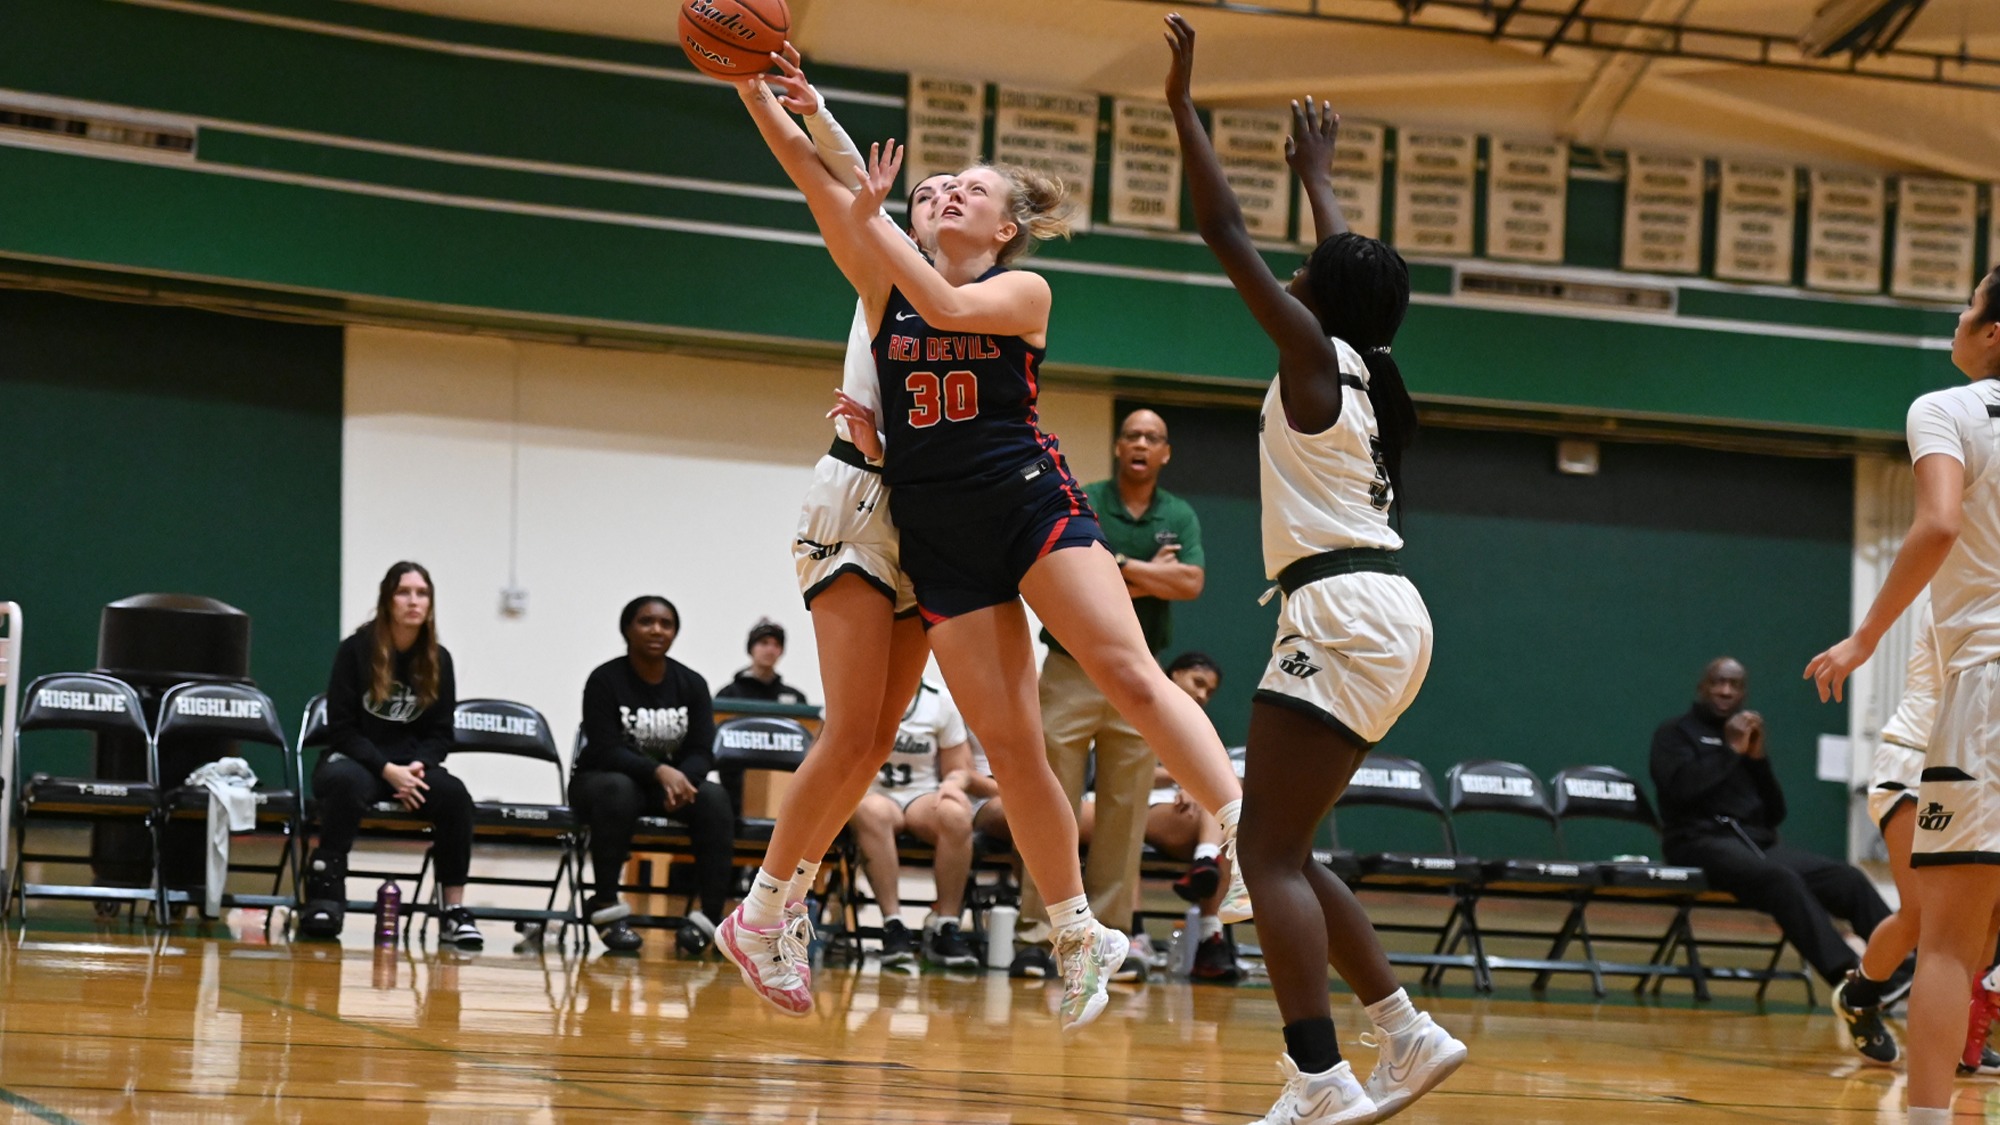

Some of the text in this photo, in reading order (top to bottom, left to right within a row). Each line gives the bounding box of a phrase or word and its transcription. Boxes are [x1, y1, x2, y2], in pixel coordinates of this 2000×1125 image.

[690, 0, 756, 40] Baden
[686, 36, 736, 68] RIVAL
[926, 335, 1001, 361] DEVILS
[905, 370, 979, 429] 30
[38, 689, 127, 713] HIGHLINE
[175, 696, 263, 718] HIGHLINE
[453, 711, 537, 736] HIGHLINE
[720, 729, 804, 752] HIGHLINE
[1460, 774, 1534, 797] HIGHLINE
[1564, 777, 1637, 801] HIGHLINE
